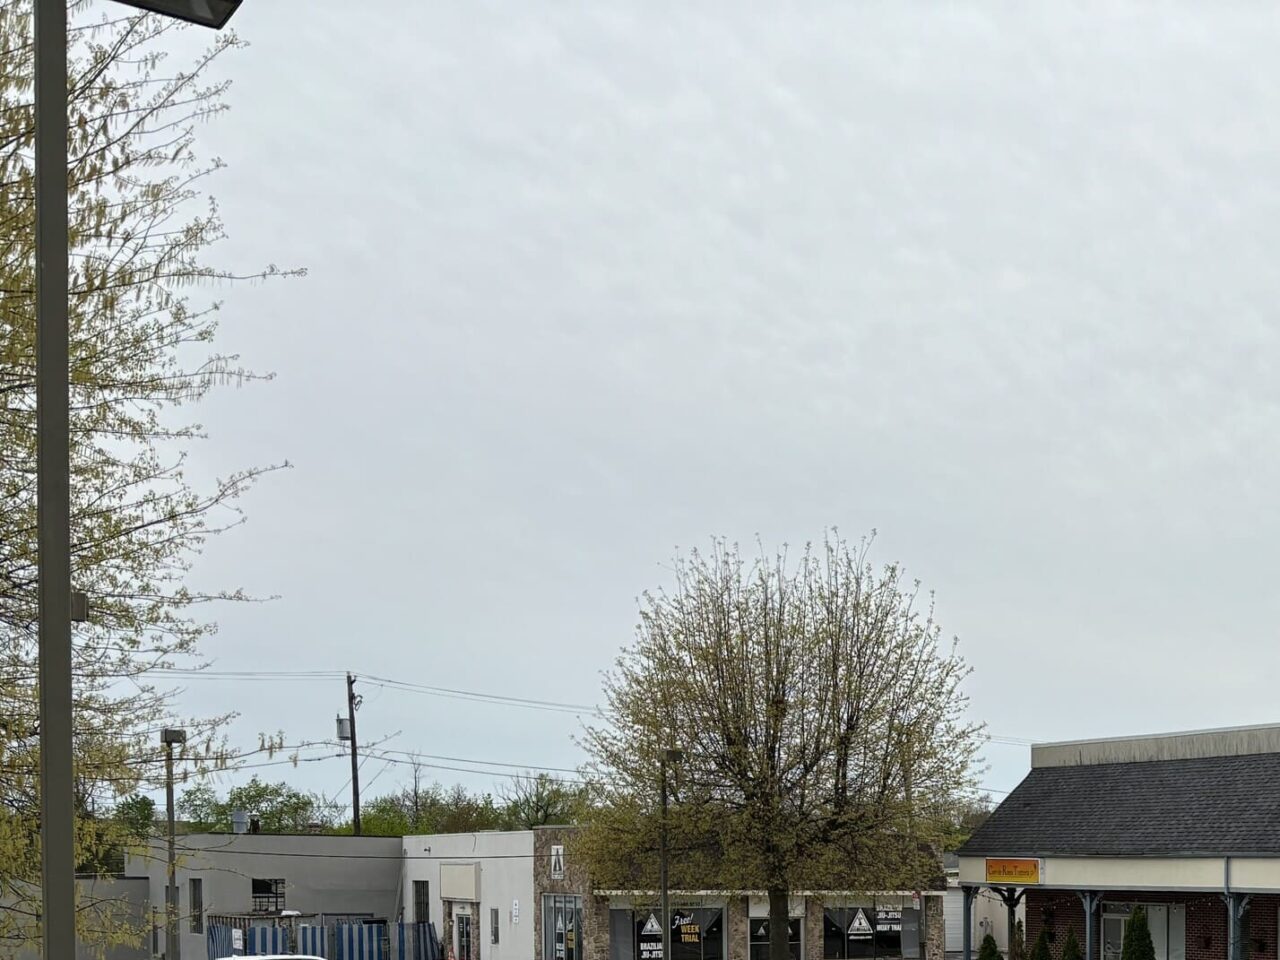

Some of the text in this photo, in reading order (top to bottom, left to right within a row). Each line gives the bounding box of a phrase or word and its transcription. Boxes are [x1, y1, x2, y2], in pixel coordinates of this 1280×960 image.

[680, 924, 700, 933] WEEK
[680, 934, 700, 942] TRIAL
[640, 942, 663, 951] BRAZILIA
